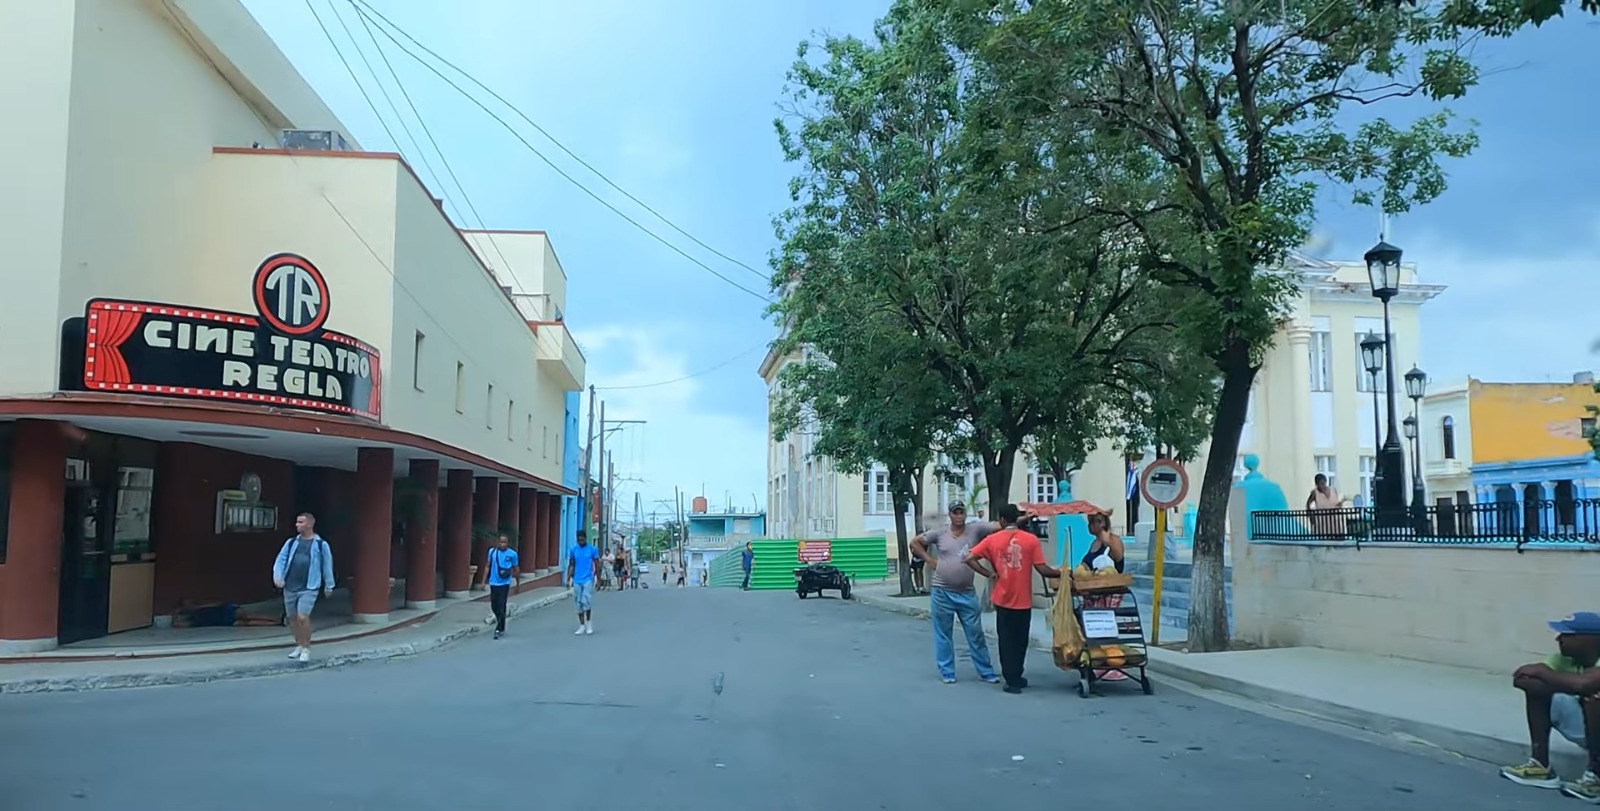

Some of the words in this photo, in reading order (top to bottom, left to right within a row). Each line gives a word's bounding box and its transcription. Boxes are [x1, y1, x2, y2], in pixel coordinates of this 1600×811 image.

[265, 265, 321, 325] TR
[144, 320, 255, 357] CINE
[270, 335, 370, 379] TEATRO
[222, 360, 343, 401] REGLA
